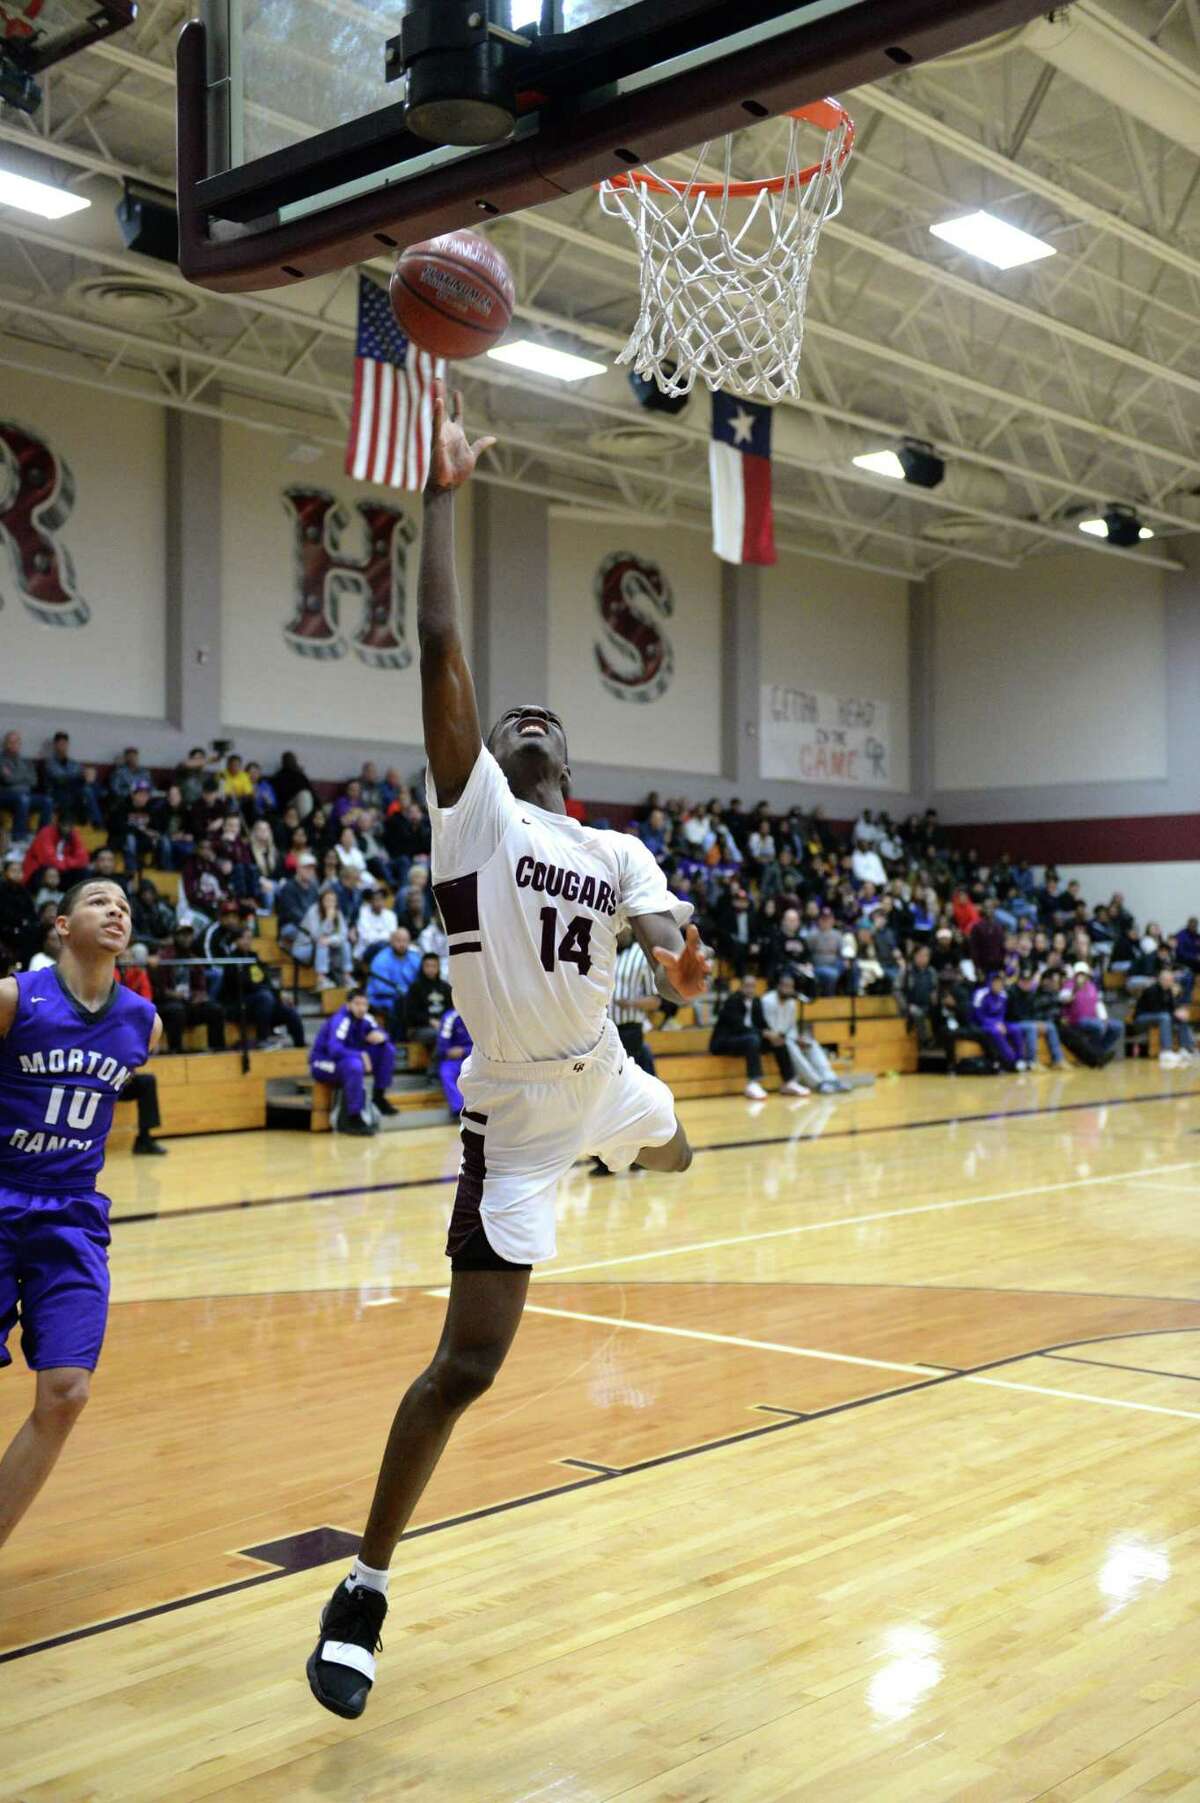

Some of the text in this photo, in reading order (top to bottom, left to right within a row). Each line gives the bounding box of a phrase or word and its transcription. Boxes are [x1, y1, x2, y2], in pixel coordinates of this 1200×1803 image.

[283, 484, 418, 669] H
[595, 551, 674, 703] S
[515, 855, 617, 917] COUGARS
[540, 906, 593, 976] 14
[19, 1048, 132, 1092] MORTON
[44, 1084, 102, 1130] 10
